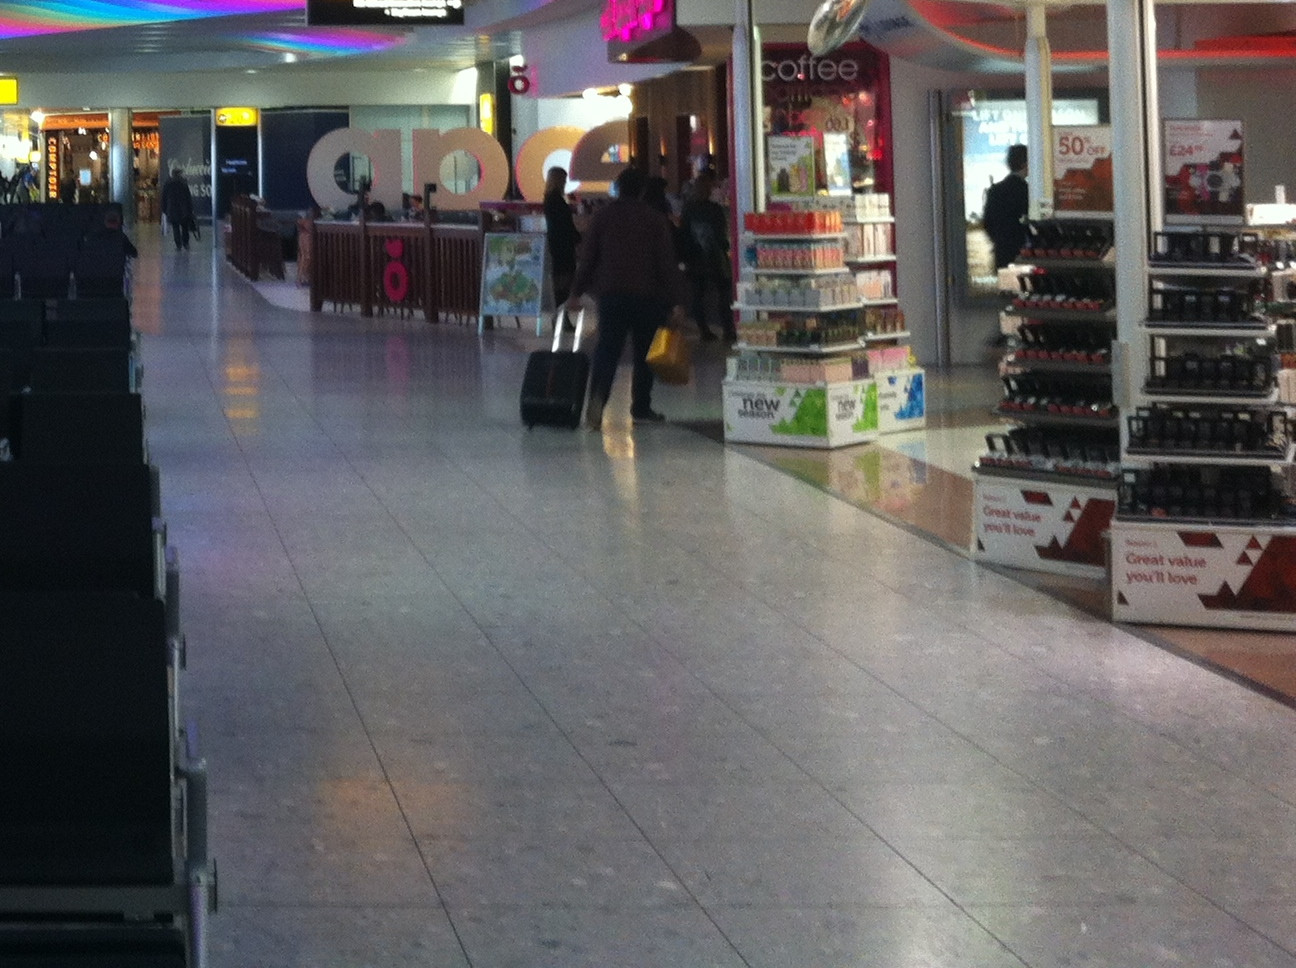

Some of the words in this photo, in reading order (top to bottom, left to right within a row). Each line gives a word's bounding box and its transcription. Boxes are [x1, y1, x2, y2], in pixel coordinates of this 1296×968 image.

[761, 54, 859, 81] coffee
[742, 397, 780, 411] new
[983, 505, 1011, 518] Great
[1013, 511, 1041, 522] value
[1013, 524, 1036, 536] love
[1126, 553, 1164, 566] Great
[1168, 557, 1207, 568] value
[1126, 572, 1165, 584] you'll
[1168, 572, 1198, 585] love
